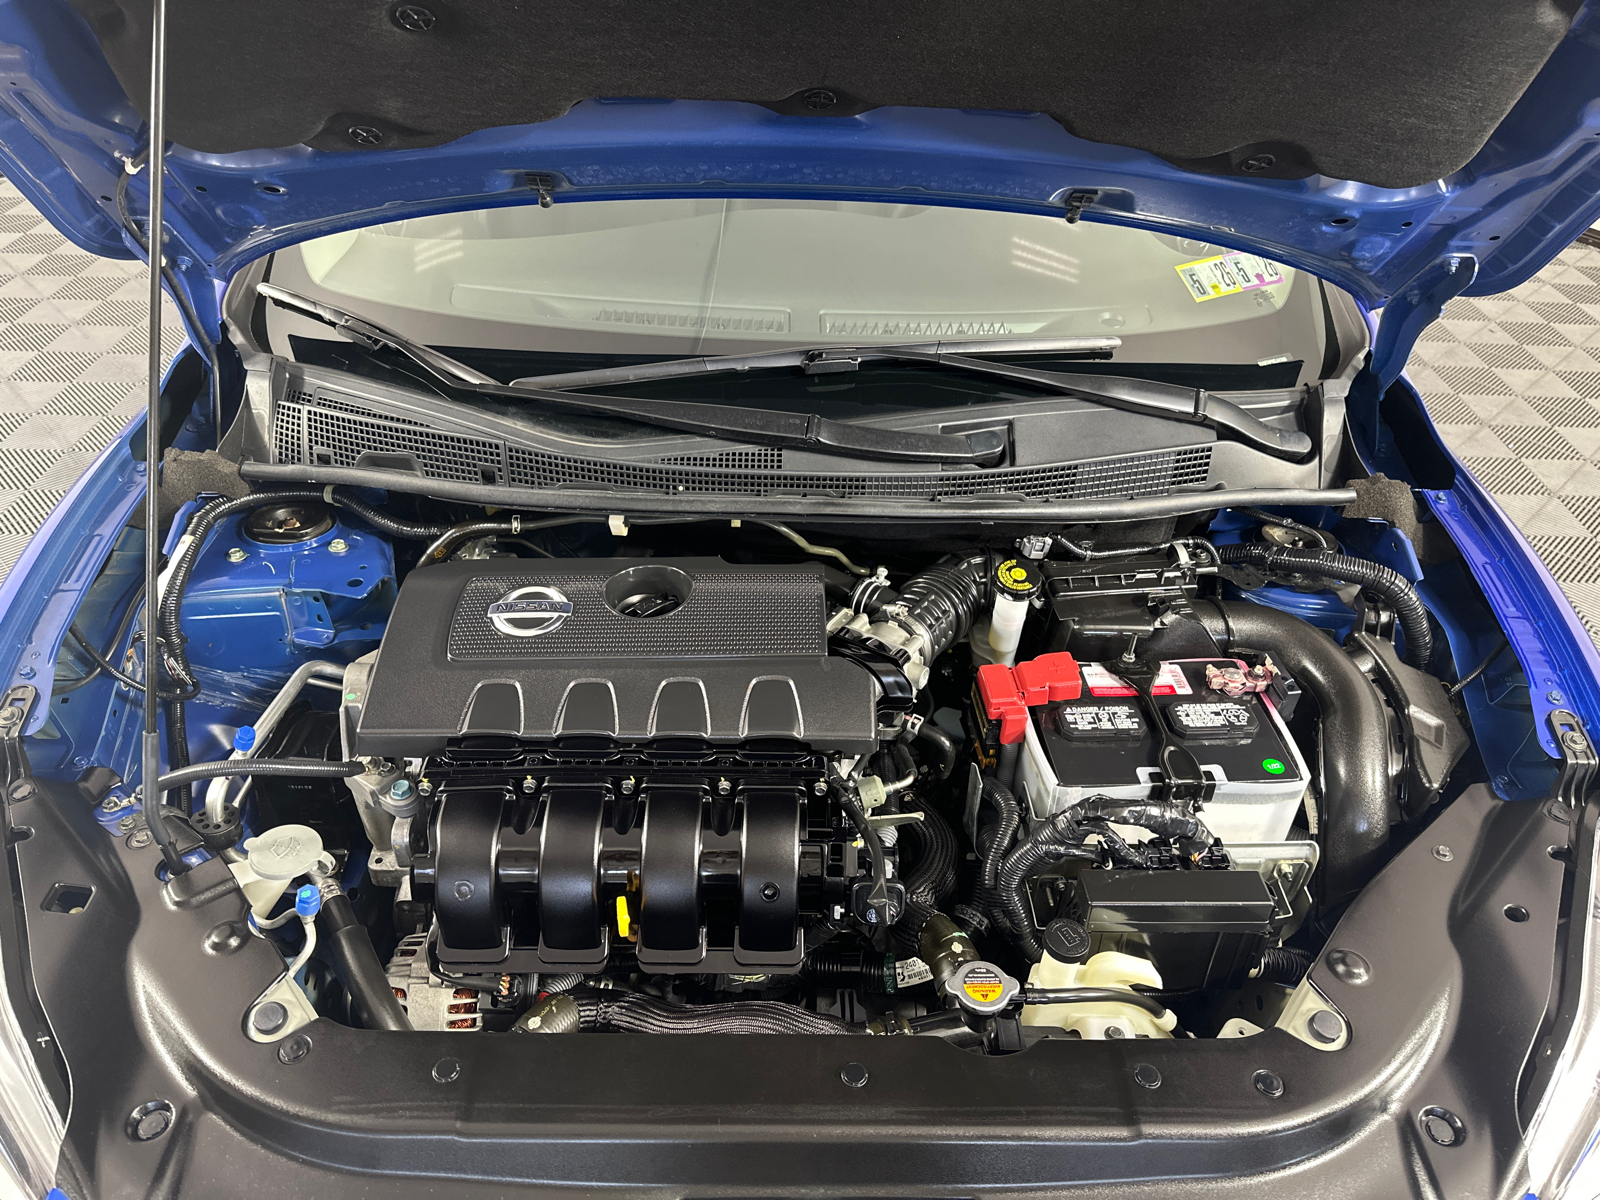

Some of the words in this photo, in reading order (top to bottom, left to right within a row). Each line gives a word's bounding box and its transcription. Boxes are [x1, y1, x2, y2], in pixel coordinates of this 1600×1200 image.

[1213, 261, 1237, 287] 26
[1233, 261, 1251, 283] 5
[1188, 273, 1207, 295] 5
[496, 601, 564, 612] NISSAN
